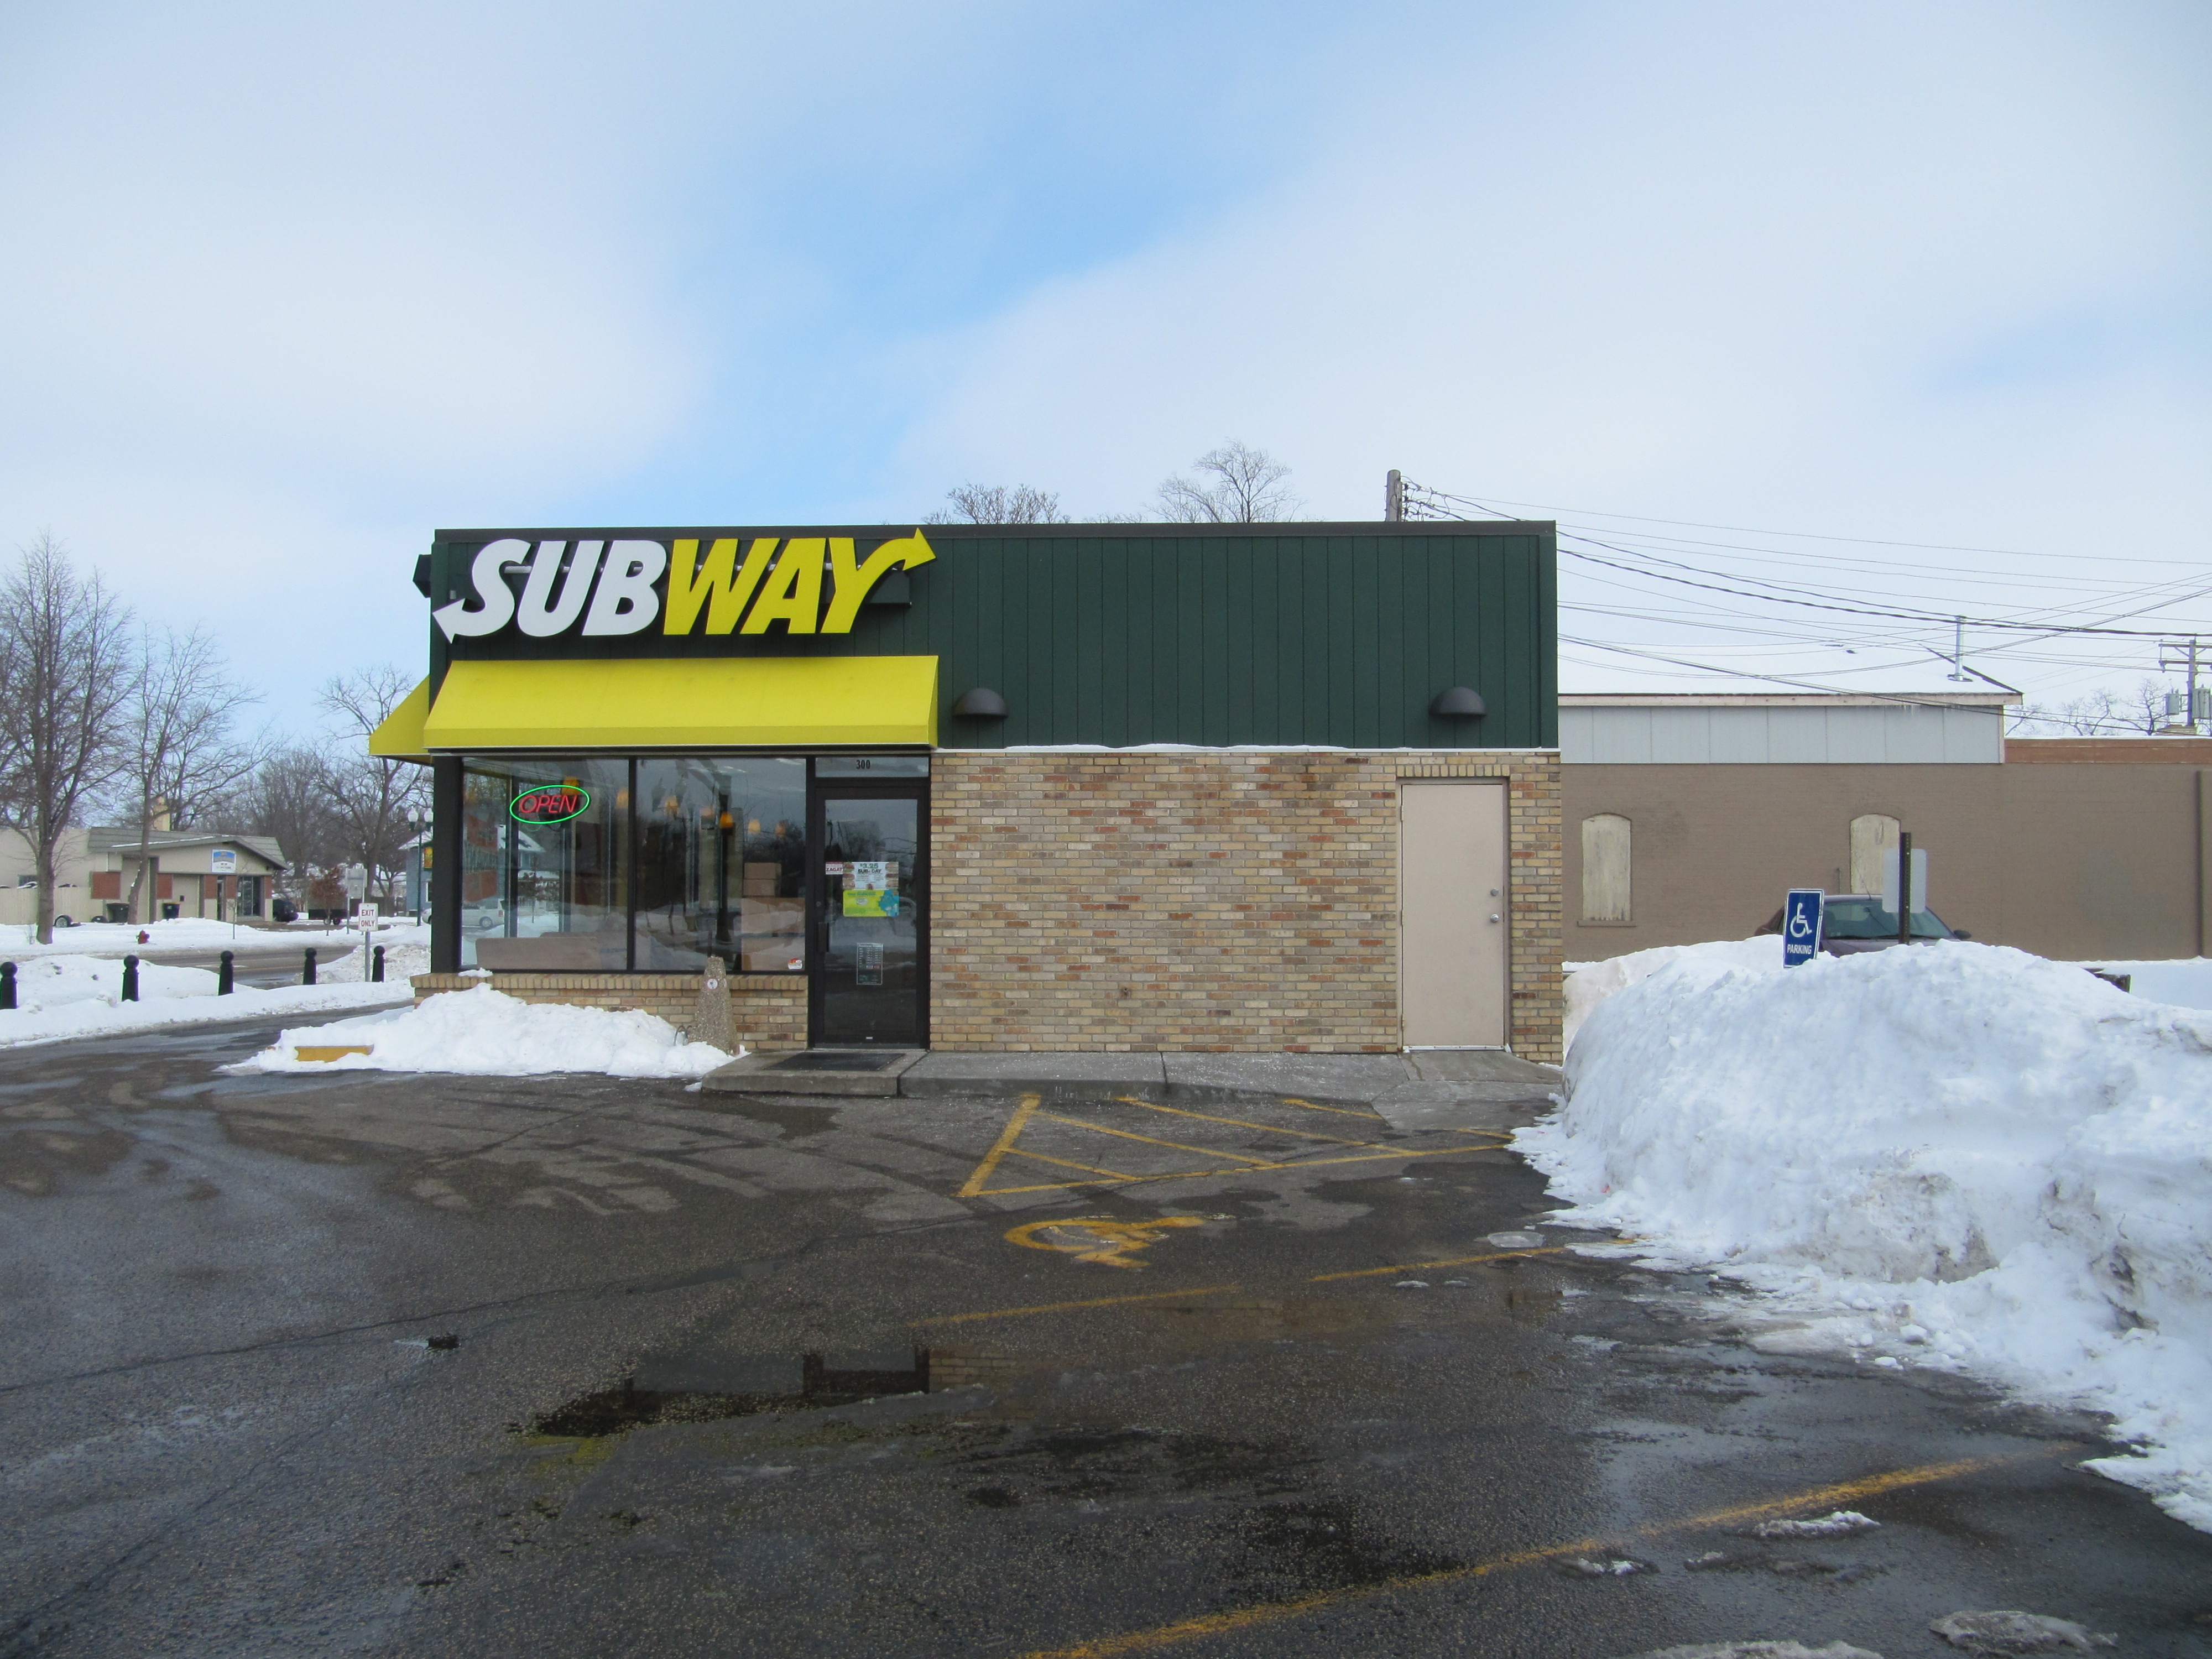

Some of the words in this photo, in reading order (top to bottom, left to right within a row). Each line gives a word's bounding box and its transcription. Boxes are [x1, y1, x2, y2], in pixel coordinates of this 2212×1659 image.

[432, 528, 937, 644] SUBWAY
[856, 759, 870, 769] 300
[519, 795, 578, 813] OPEN
[1787, 944, 1812, 954] PARKING
